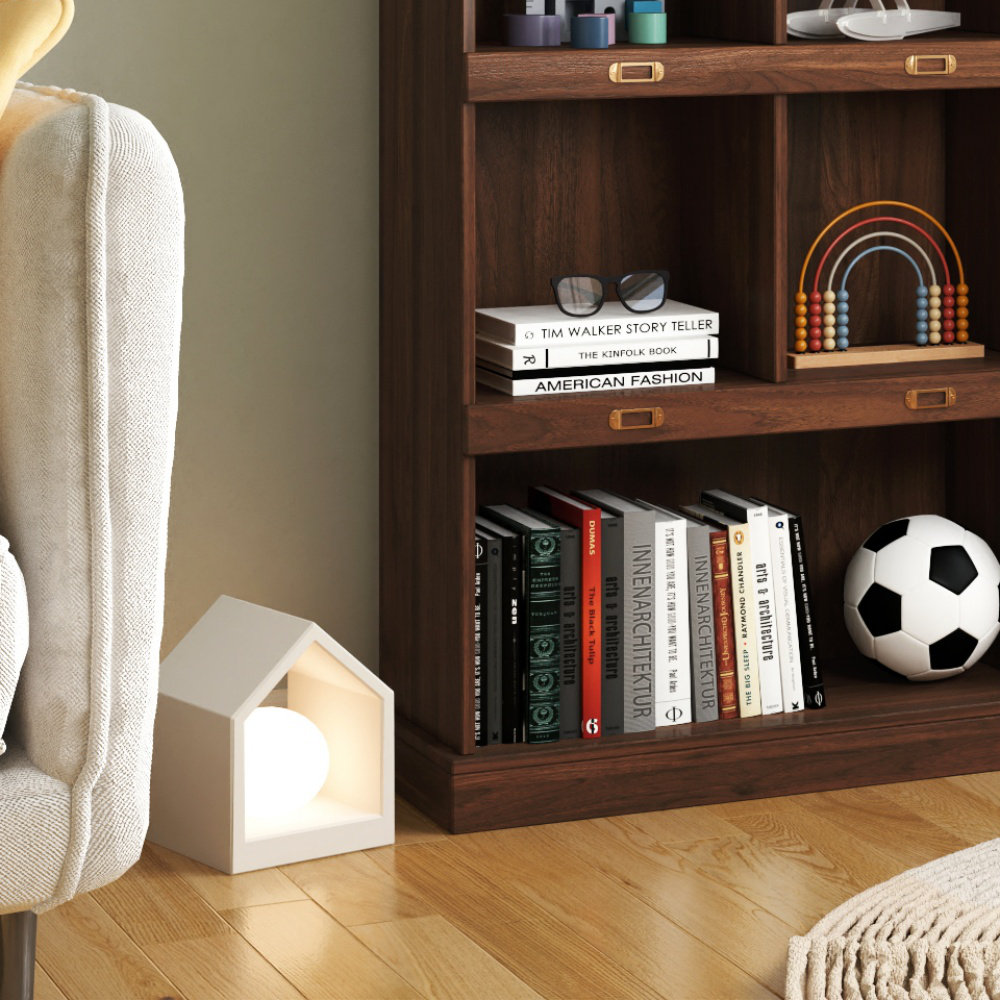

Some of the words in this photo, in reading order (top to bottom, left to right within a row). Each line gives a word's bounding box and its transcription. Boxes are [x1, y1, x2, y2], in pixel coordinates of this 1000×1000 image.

[541, 328, 564, 339] TIM
[568, 324, 622, 337] WALKER
[626, 321, 668, 334] STORY
[671, 319, 713, 331] TELLER
[578, 351, 598, 360] THE
[602, 348, 645, 358] KINFOLK
[649, 346, 677, 356] BOOK
[535, 376, 625, 393] AMERICAN
[631, 371, 703, 386] FASHION
[588, 520, 596, 556] DUMAS
[736, 550, 746, 594] CHANDLER
[755, 562, 769, 583] arts
[588, 586, 596, 607] The
[588, 609, 596, 636] Black
[631, 543, 653, 720] INNENARCHITEKTUR
[694, 555, 716, 711] INNENARCHITEKTUR
[739, 596, 748, 639] RAYMOND
[759, 599, 774, 661] architecture
[563, 623, 578, 685] architecture
[586, 639, 596, 665] Tulip
[605, 614, 620, 680] architecture
[744, 691, 752, 706] THE
